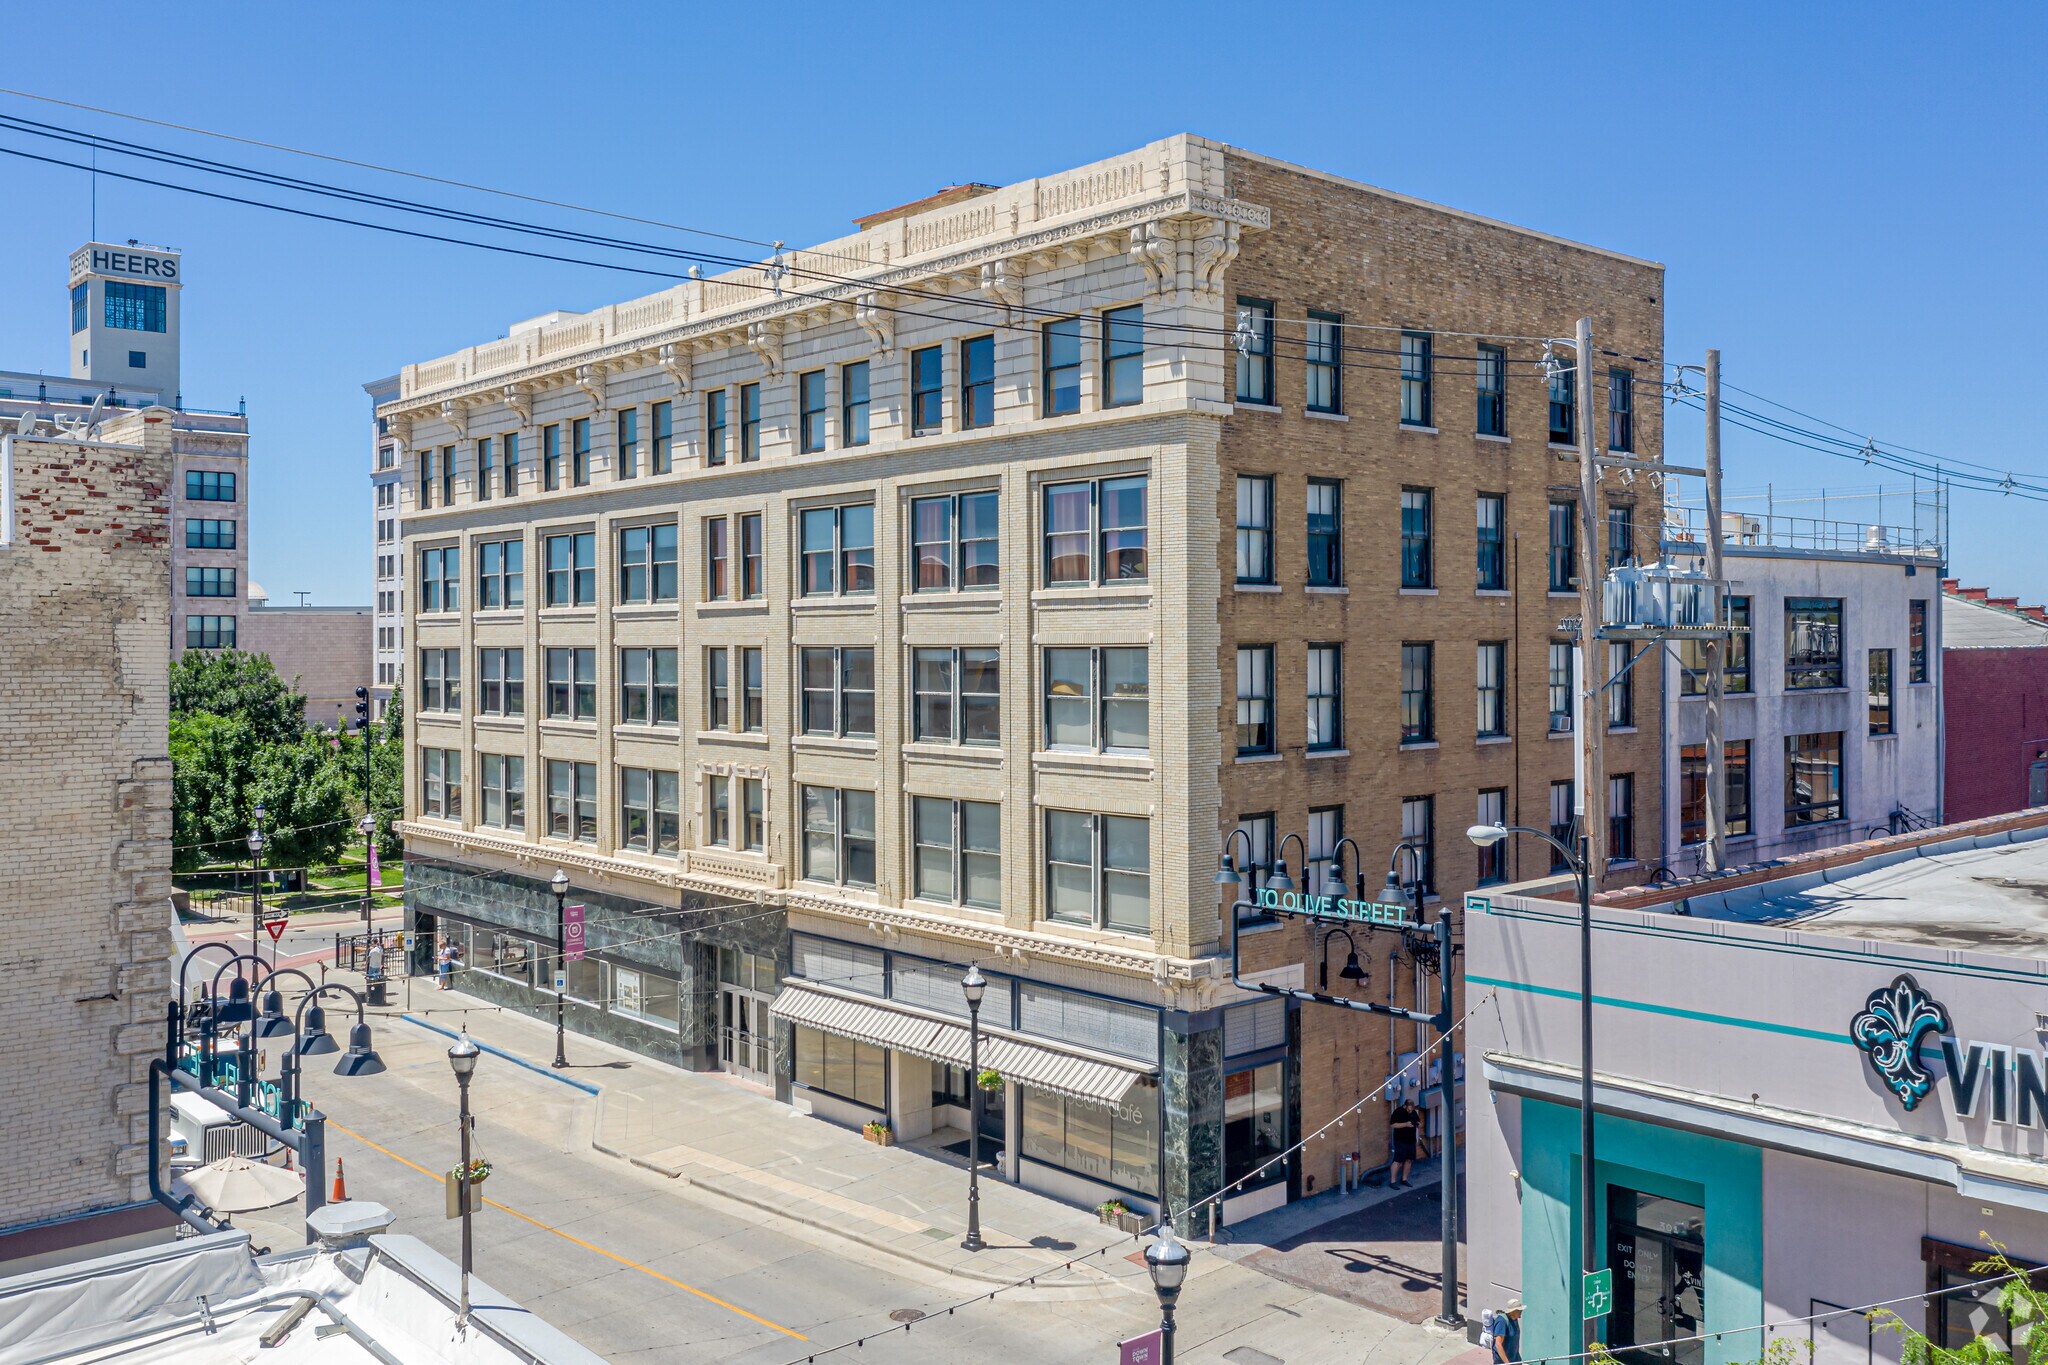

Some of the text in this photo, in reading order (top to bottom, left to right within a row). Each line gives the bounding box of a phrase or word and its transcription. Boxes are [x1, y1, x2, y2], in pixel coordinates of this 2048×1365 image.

[93, 250, 176, 277] HEERS
[1256, 888, 1407, 926] TO OLIVE STREET
[1617, 1243, 1658, 1260] EXIT ONLY
[1623, 1259, 1652, 1273] DO OT
